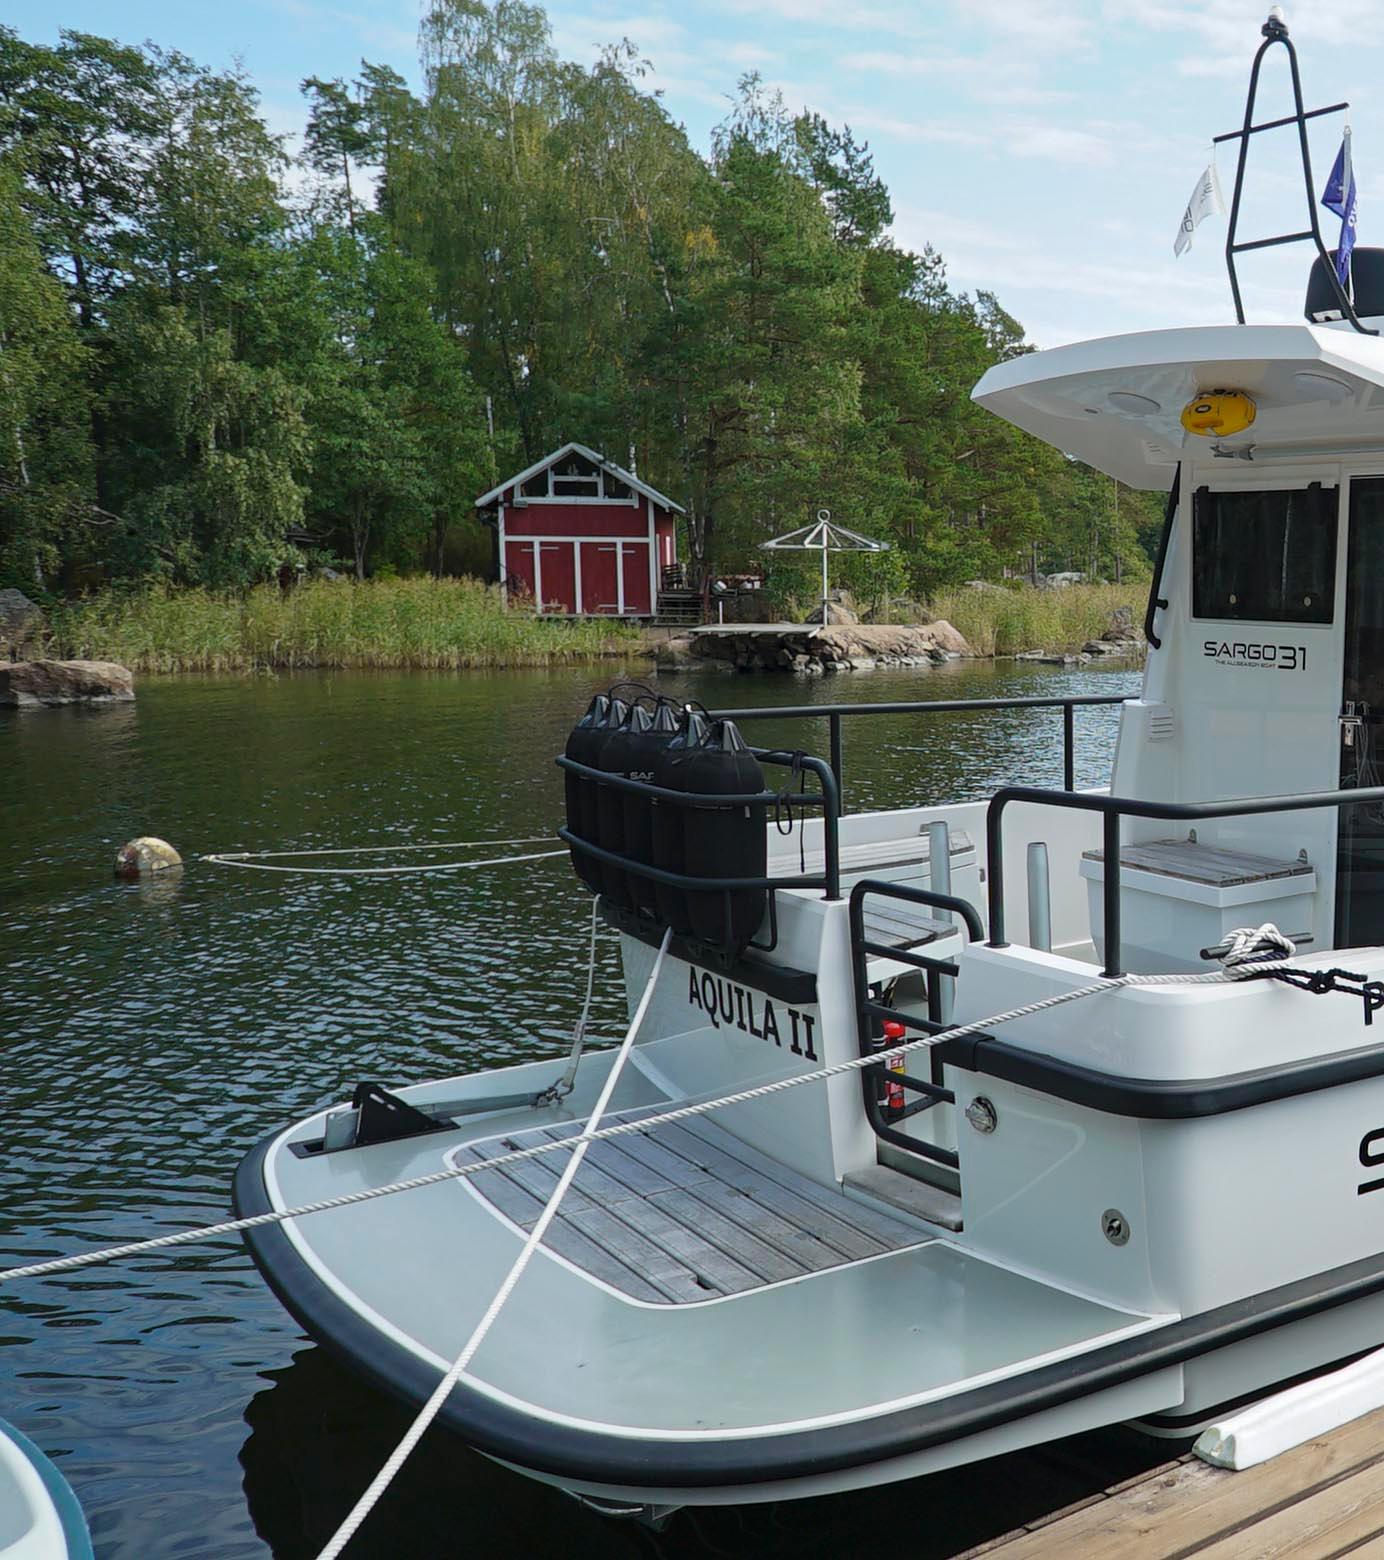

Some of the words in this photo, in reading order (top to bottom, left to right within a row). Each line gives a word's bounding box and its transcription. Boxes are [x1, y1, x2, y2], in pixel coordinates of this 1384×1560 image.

[1203, 641, 1277, 661] SARGO
[1277, 645, 1306, 671] 31
[688, 965, 782, 1047] AQUILA
[787, 1008, 818, 1062] II
